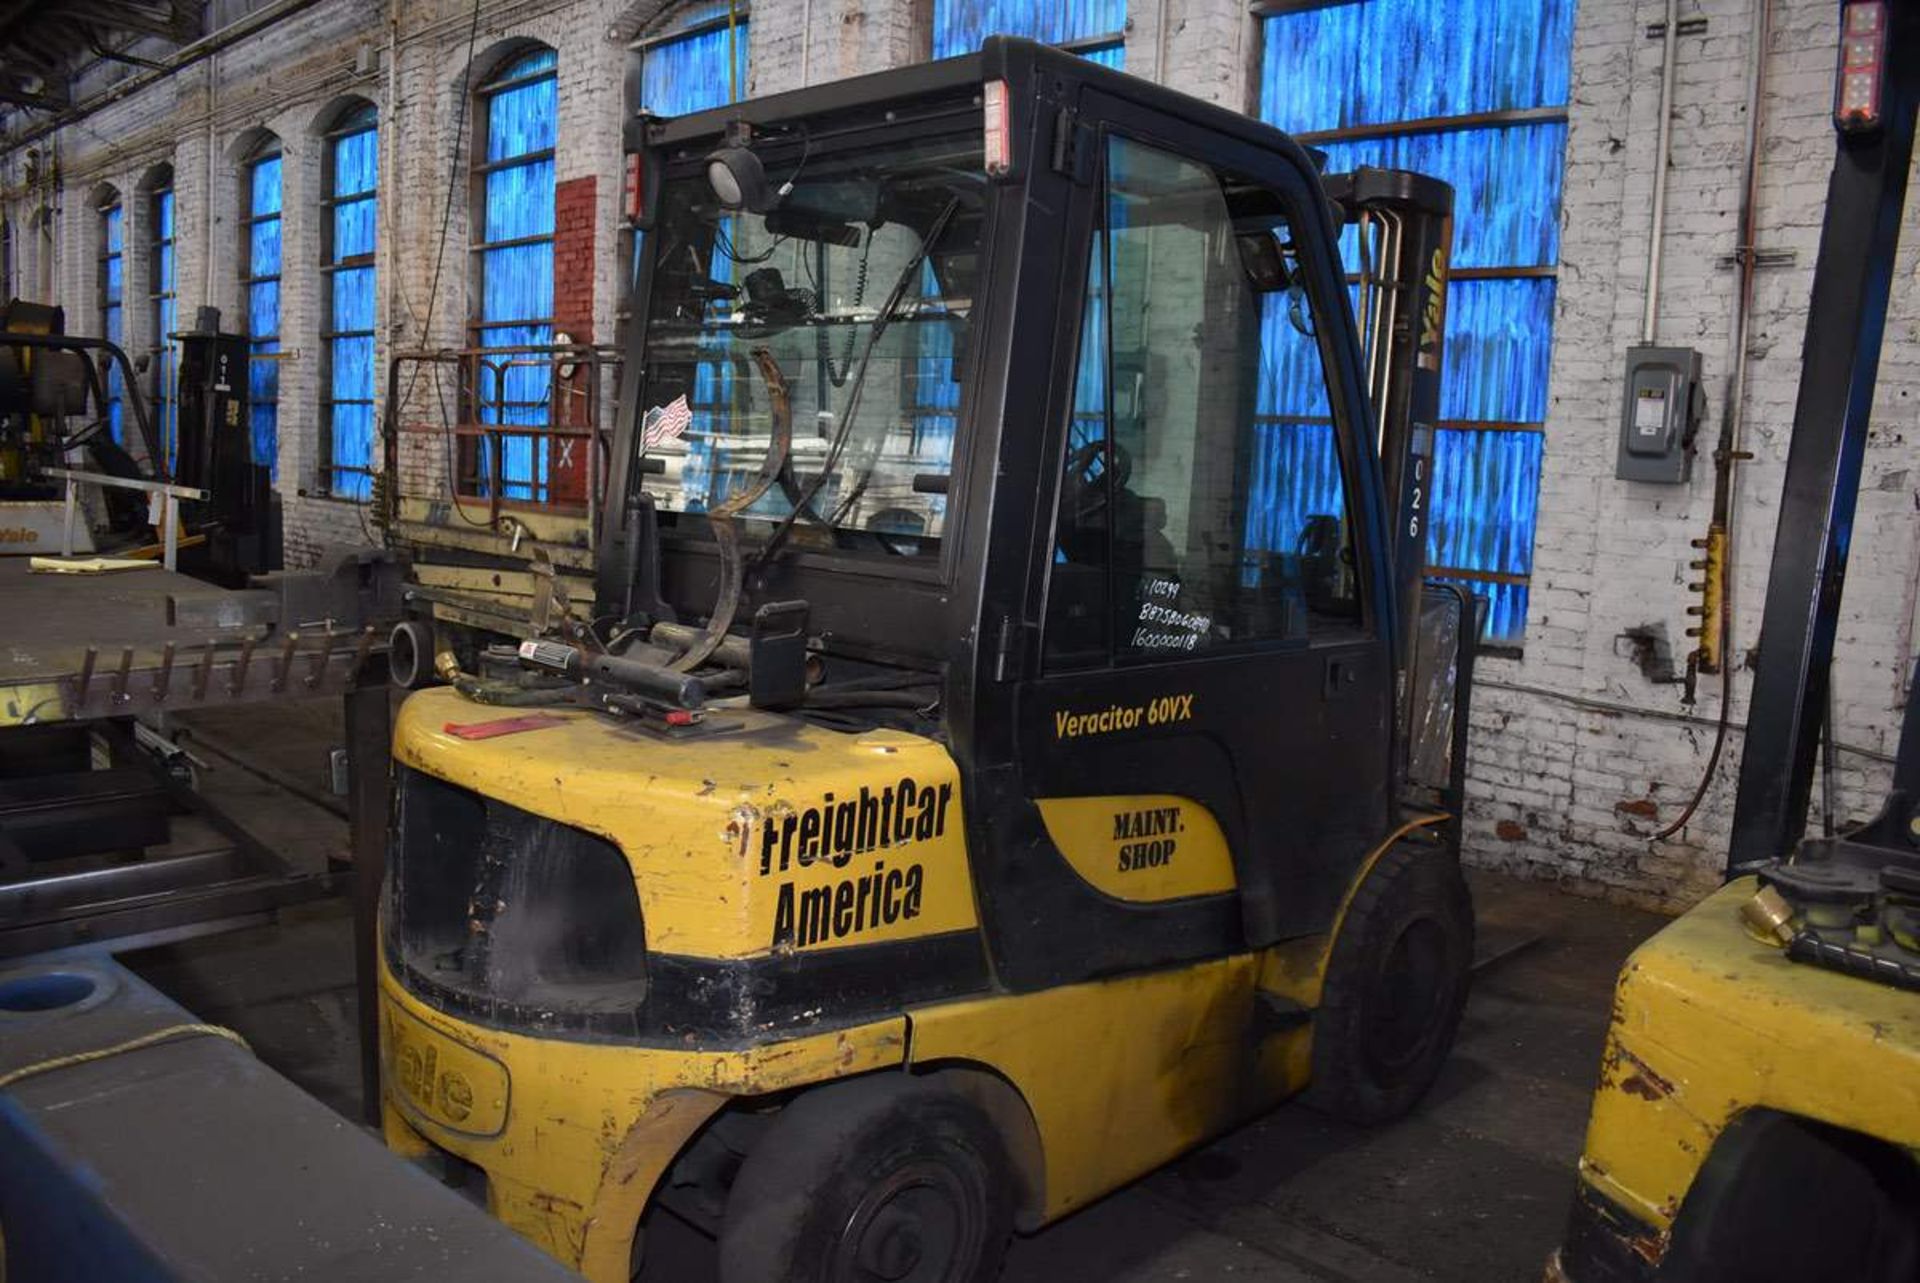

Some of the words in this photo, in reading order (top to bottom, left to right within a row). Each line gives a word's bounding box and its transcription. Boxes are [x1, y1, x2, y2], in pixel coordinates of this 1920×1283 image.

[1420, 248, 1446, 346] Yale
[1409, 459, 1424, 538] 026
[1056, 704, 1144, 739] Veracitor
[1147, 694, 1193, 725] 60VX
[759, 778, 953, 876] FreightCar
[1112, 805, 1185, 842] MAINT.
[1117, 838, 1176, 873] SHOP
[771, 862, 924, 950] America
